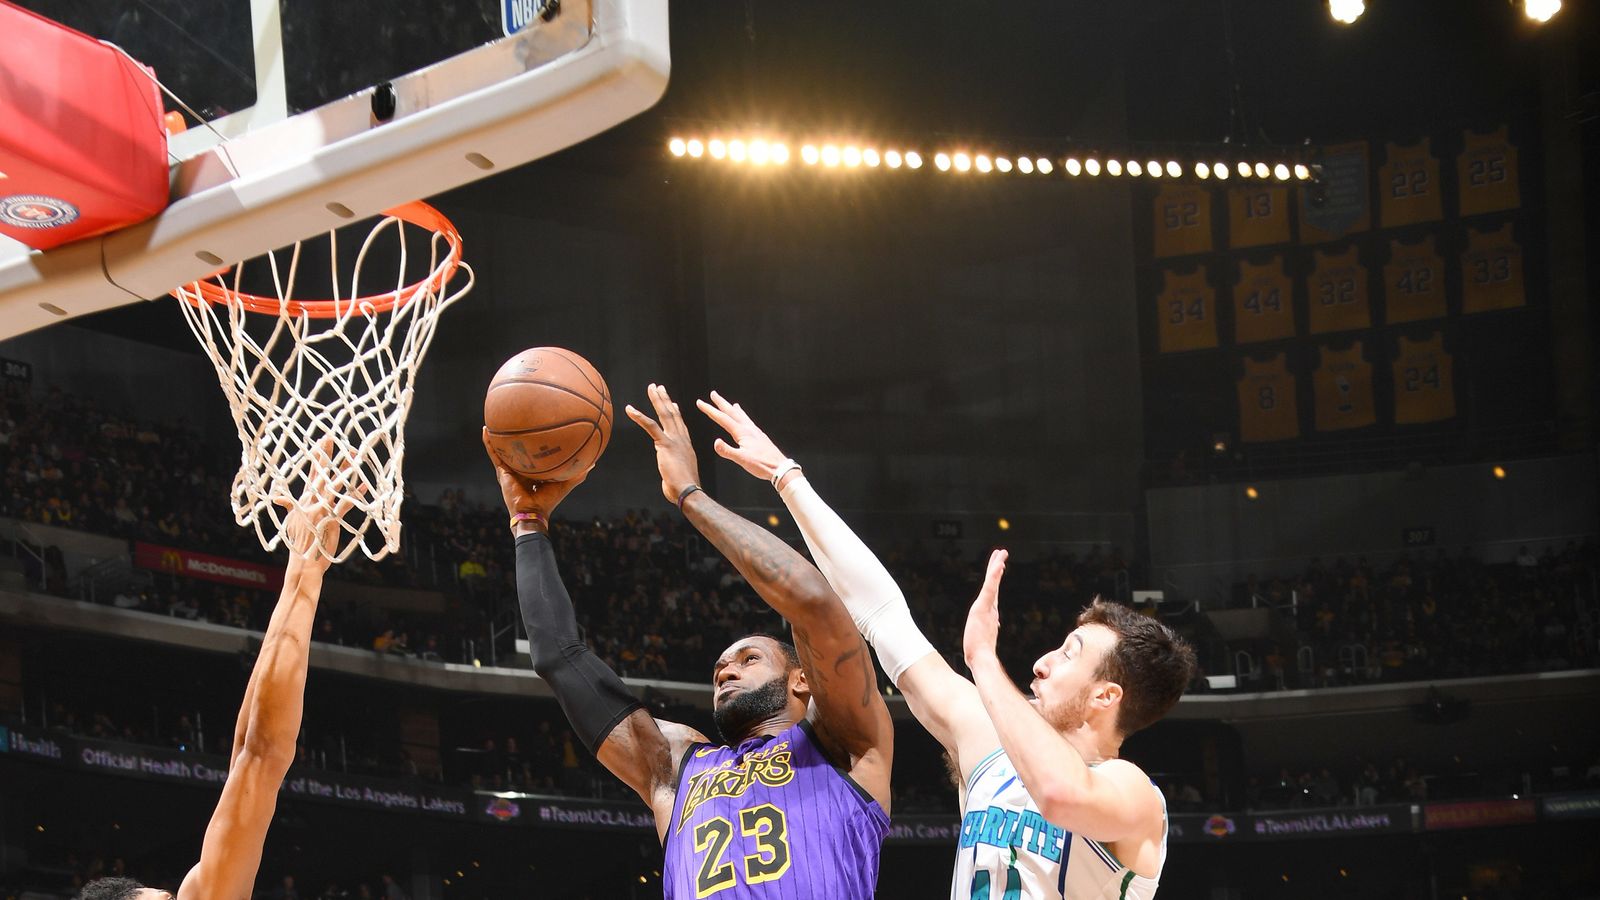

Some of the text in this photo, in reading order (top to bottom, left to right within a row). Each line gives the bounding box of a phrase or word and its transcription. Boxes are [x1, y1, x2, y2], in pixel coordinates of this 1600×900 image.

[511, 0, 542, 29] NBA
[1392, 169, 1429, 199] 22
[1470, 159, 1507, 188] 25
[1164, 201, 1201, 230] 52
[1245, 192, 1273, 219] 13
[1395, 267, 1433, 296] 42
[1472, 255, 1511, 285] 33
[1243, 287, 1282, 316] 44
[1320, 278, 1357, 307] 32
[1168, 297, 1205, 326] 34
[1404, 364, 1440, 393] 24
[1259, 384, 1277, 412] 8
[187, 558, 268, 584] McDonald's
[82, 748, 138, 770] Official
[140, 757, 191, 778] Health
[193, 764, 229, 783] Care
[291, 778, 306, 793] of
[308, 778, 334, 797] the
[336, 784, 362, 801] Los
[363, 786, 418, 808] Angeles
[421, 796, 466, 815] Lakers
[539, 806, 655, 828] #TeamUCLALak
[916, 822, 949, 839] Care
[1254, 813, 1391, 835] #TeamUCLALakers
[693, 803, 791, 899] 23
